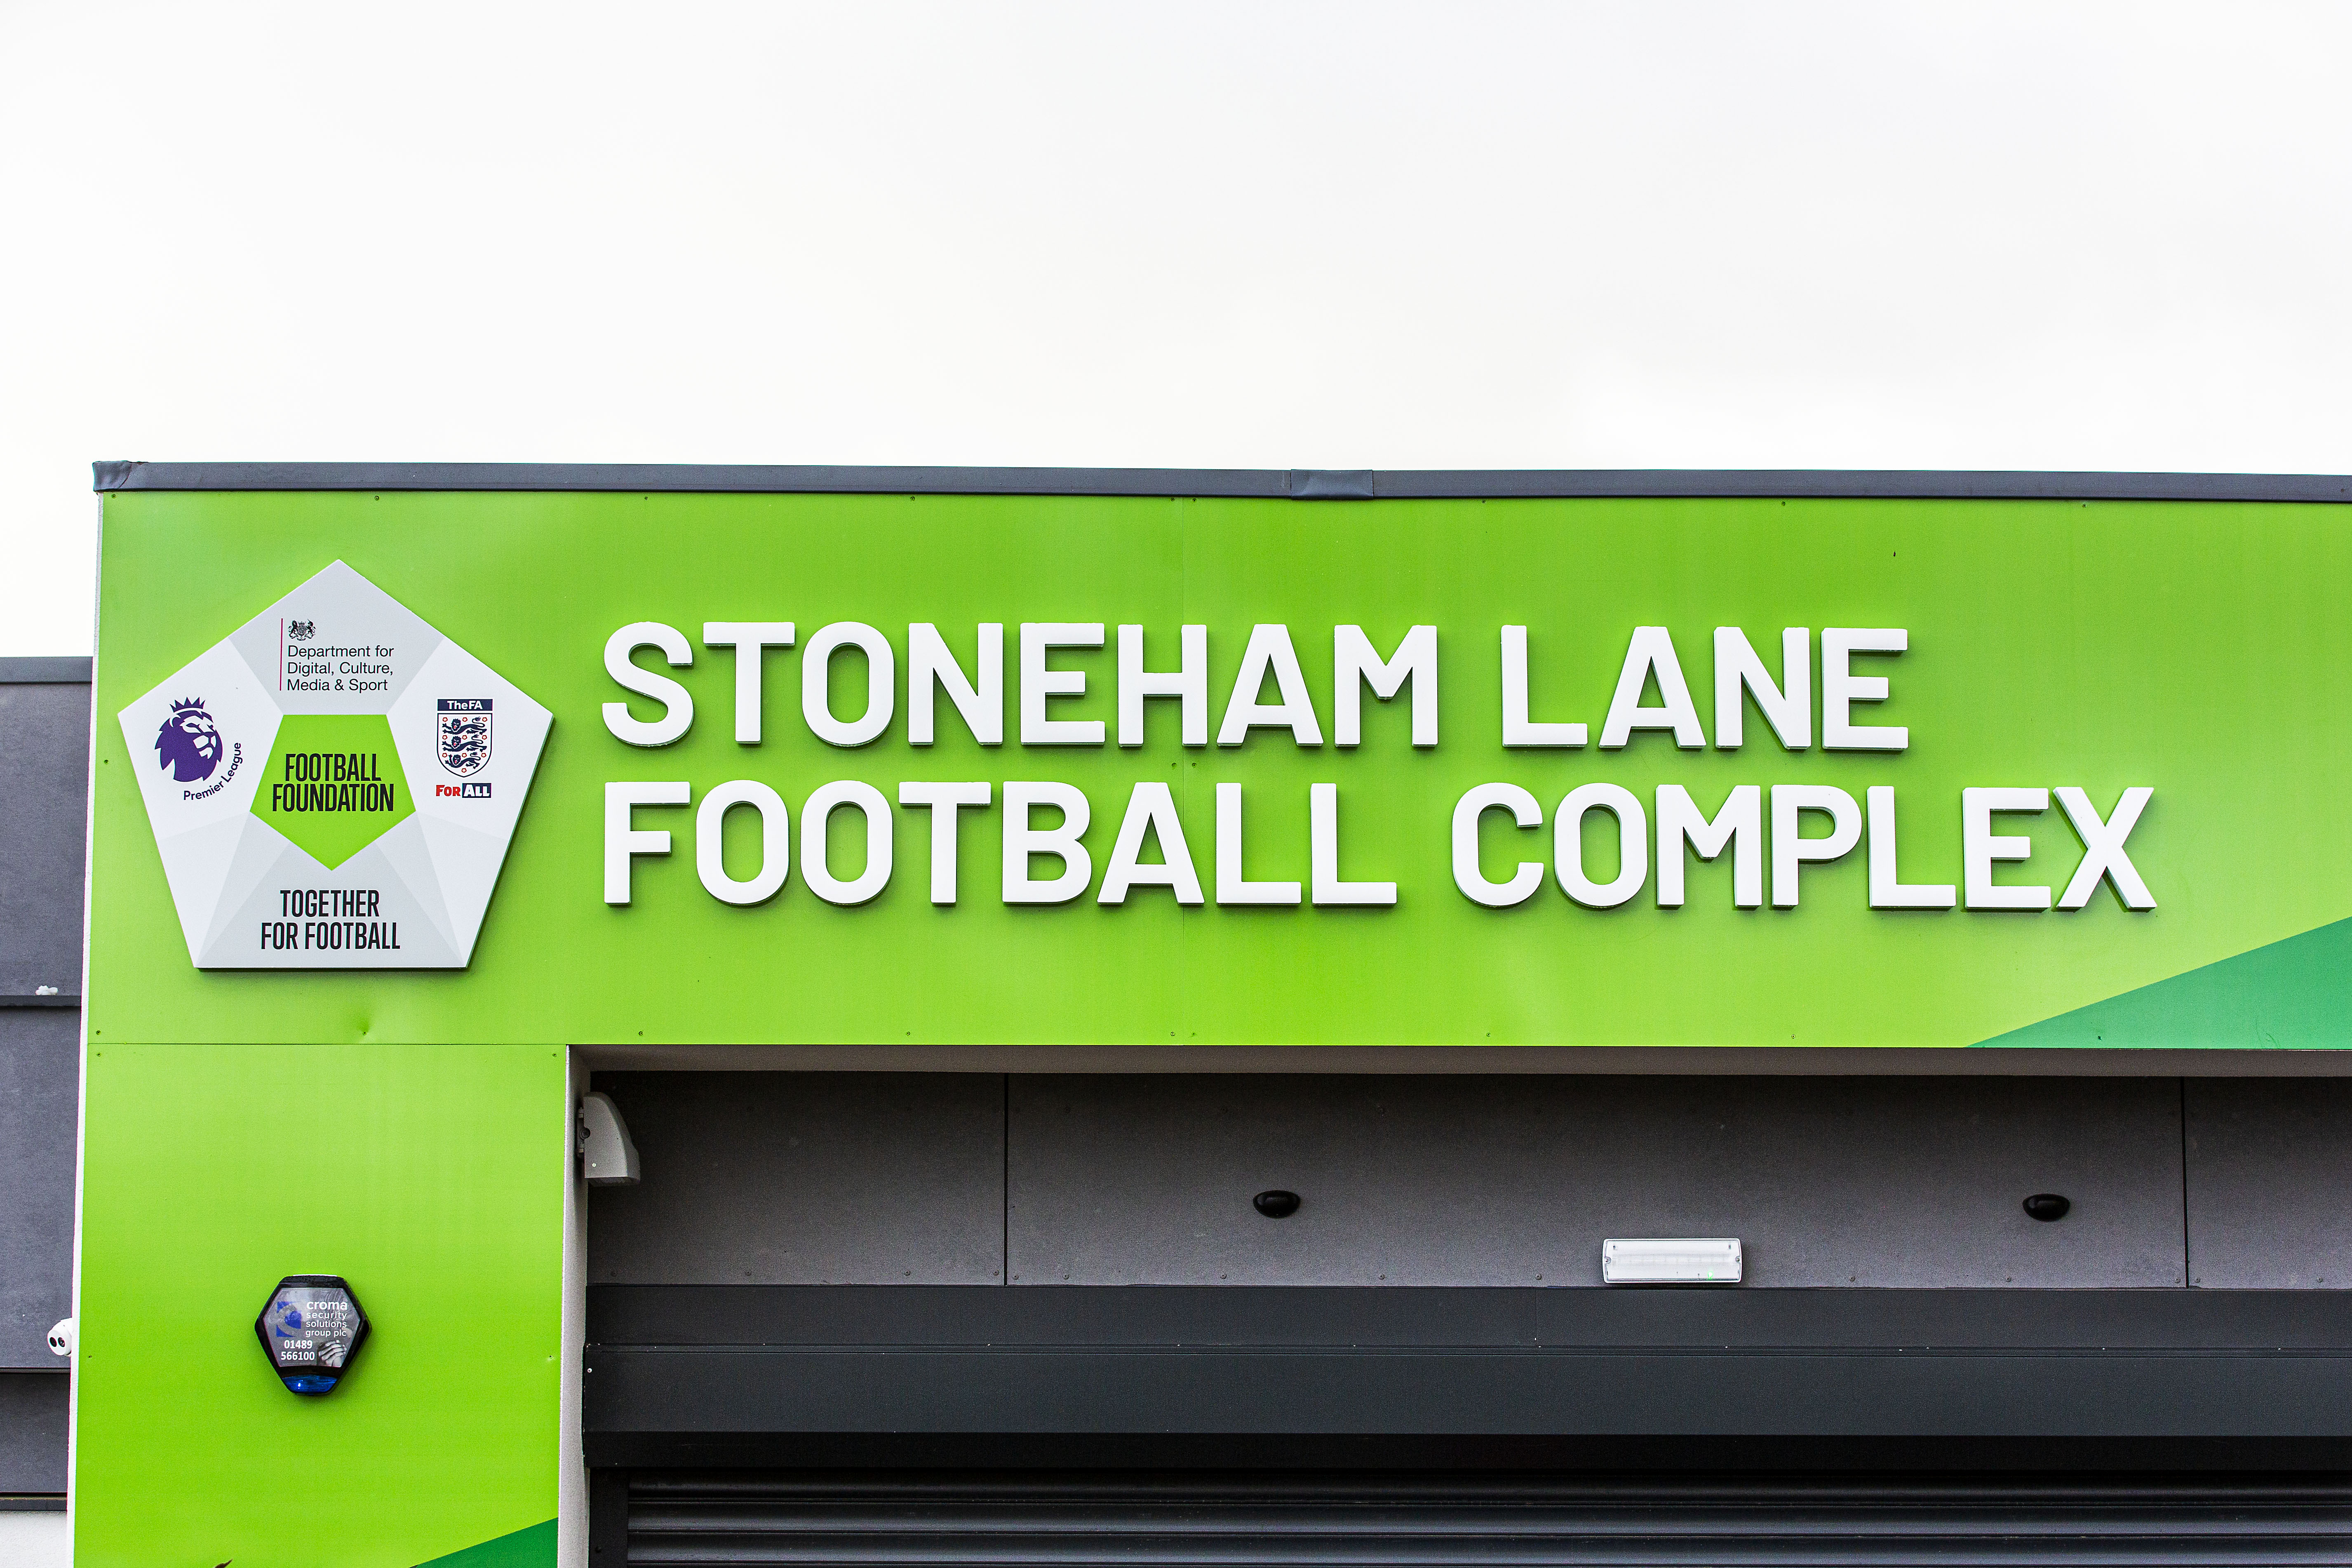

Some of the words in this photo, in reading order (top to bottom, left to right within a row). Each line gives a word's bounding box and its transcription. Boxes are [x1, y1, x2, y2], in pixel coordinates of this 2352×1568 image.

[288, 645, 371, 660] Department
[375, 645, 395, 657] for
[287, 662, 334, 677] Digital,
[340, 662, 393, 676] Culture,
[287, 679, 330, 691] Media
[334, 679, 345, 691] &
[349, 678, 388, 694] Sport
[602, 621, 1438, 747] STONEHAM
[1501, 625, 1909, 750] LANE
[183, 780, 224, 801] Premier
[221, 742, 243, 783] League
[285, 753, 382, 782] FOOTBALL
[273, 783, 394, 812] FOUNDATION
[604, 780, 1398, 906] FOOTBALL
[1452, 782, 2158, 910] COMPLEX
[280, 889, 380, 917] TOGETHER
[261, 922, 298, 950] FOR
[305, 922, 400, 950] FOOTBALL
[306, 1301, 348, 1310] croma
[306, 1311, 347, 1320] security
[334, 1329, 346, 1337] plc
[284, 1340, 313, 1349] 01489
[281, 1351, 315, 1361] 566100
